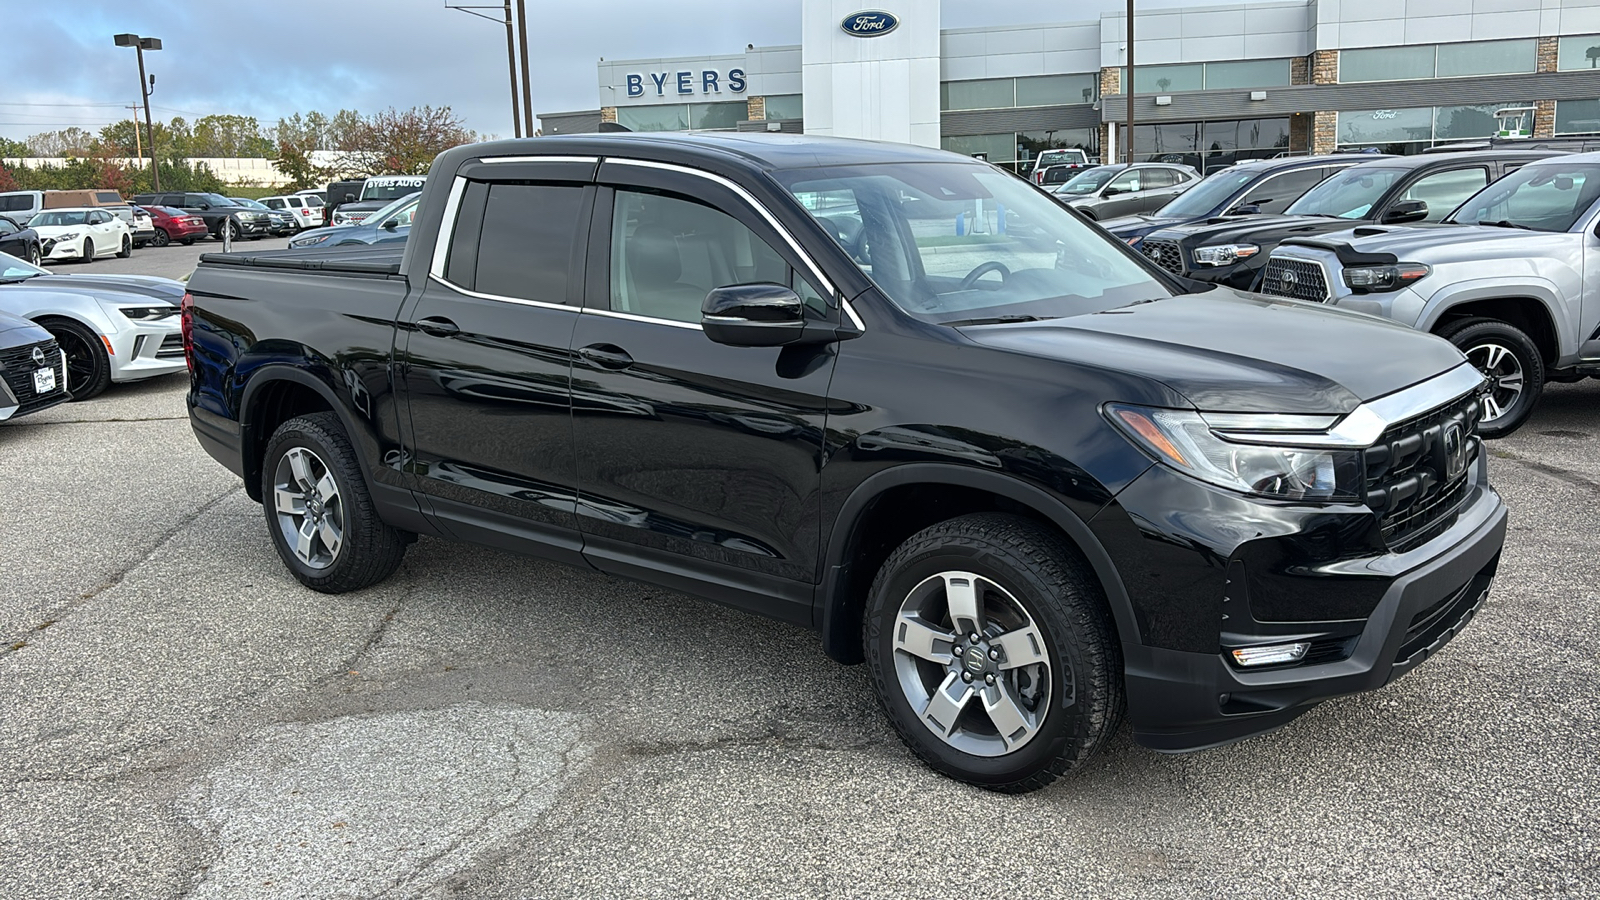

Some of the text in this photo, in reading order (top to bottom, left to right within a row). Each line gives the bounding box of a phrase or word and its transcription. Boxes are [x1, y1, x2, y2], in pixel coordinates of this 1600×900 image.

[853, 15, 885, 31] Ford
[626, 68, 747, 98] BYERS
[1372, 109, 1397, 120] Ford
[367, 180, 422, 188] BYERS AUTO
